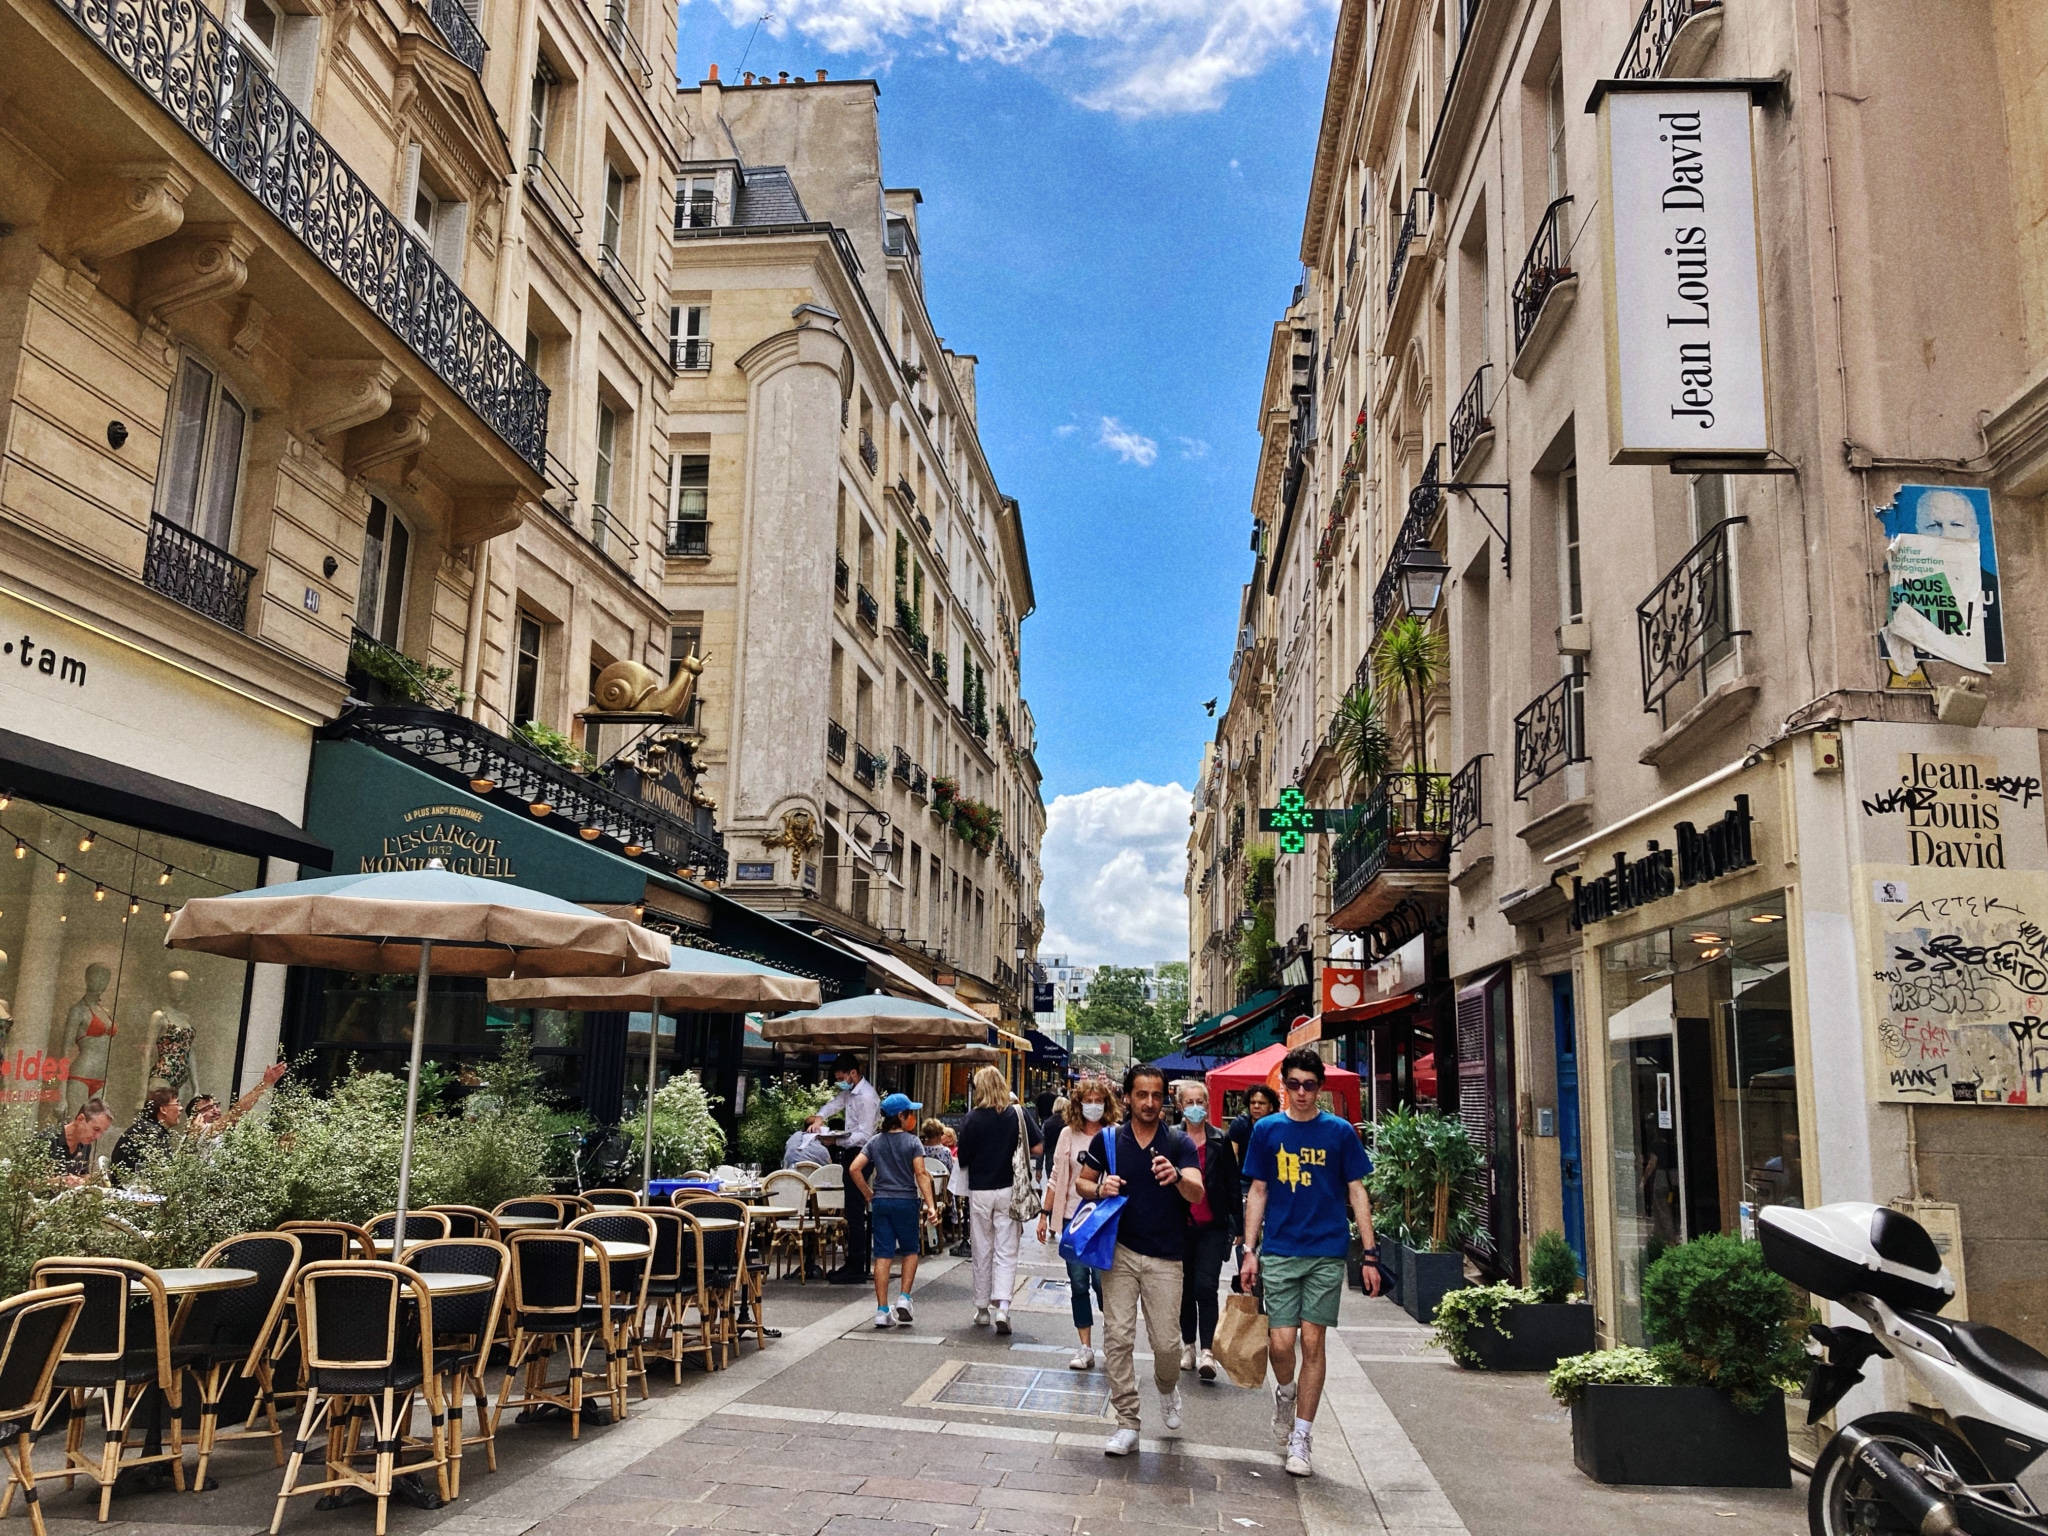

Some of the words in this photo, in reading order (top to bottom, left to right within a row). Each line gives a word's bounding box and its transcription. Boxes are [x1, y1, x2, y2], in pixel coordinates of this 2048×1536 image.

[1658, 109, 1706, 213] David
[1664, 226, 1710, 329] Louis
[1670, 340, 1715, 429] Jean
[306, 590, 319, 612] 40
[1892, 592, 1957, 608] SOMMES
[1902, 578, 1943, 592] NOUS
[1902, 752, 1981, 790] Jean
[404, 812, 414, 823] LA
[413, 807, 430, 819] PLUS
[641, 779, 695, 825] MONTORGUEIL
[1907, 792, 2000, 830] Louis
[384, 823, 502, 857] L'ESCARGOT
[1907, 830, 2007, 869] David
[1571, 876, 1613, 931] Jean
[1612, 840, 1676, 912] Louis
[1674, 794, 1758, 889] David
[1300, 1147, 1326, 1166] 512
